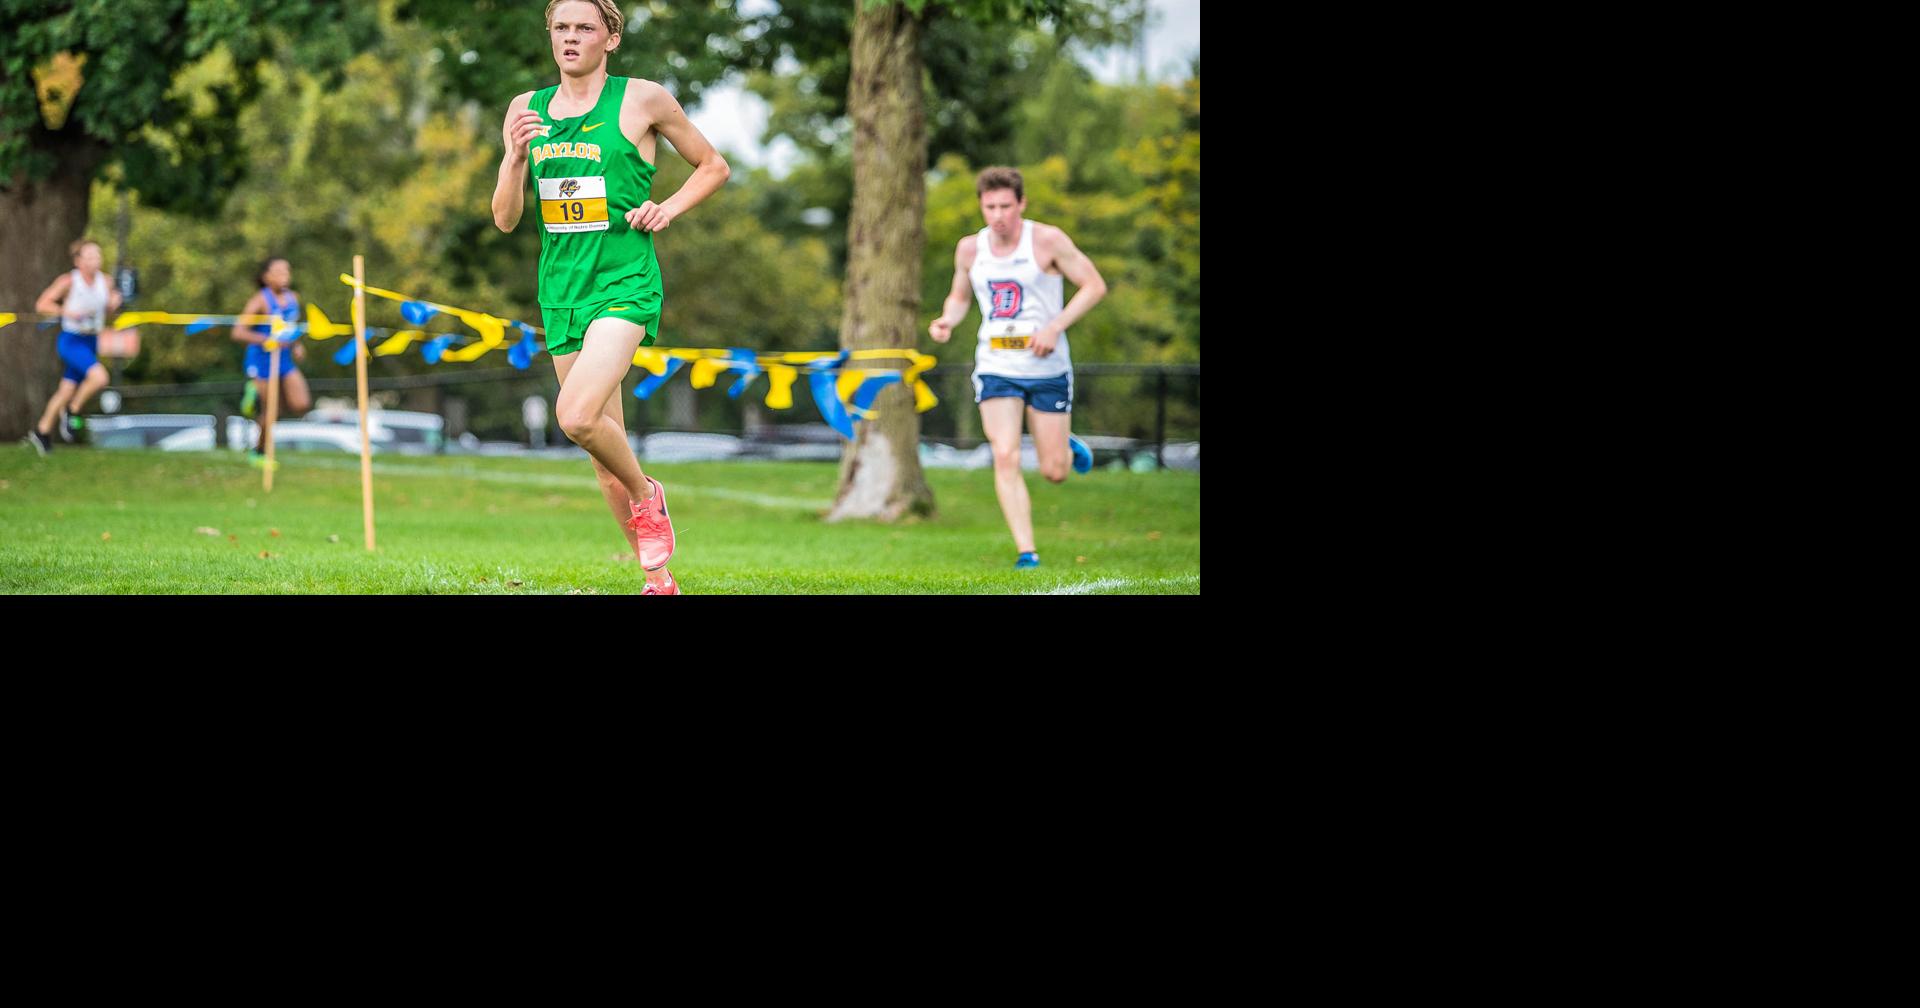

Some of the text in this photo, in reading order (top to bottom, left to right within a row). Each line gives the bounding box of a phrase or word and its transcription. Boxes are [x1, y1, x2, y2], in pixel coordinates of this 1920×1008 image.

[532, 142, 601, 166] BAYLOR
[560, 202, 584, 222] 19
[987, 280, 1024, 321] D
